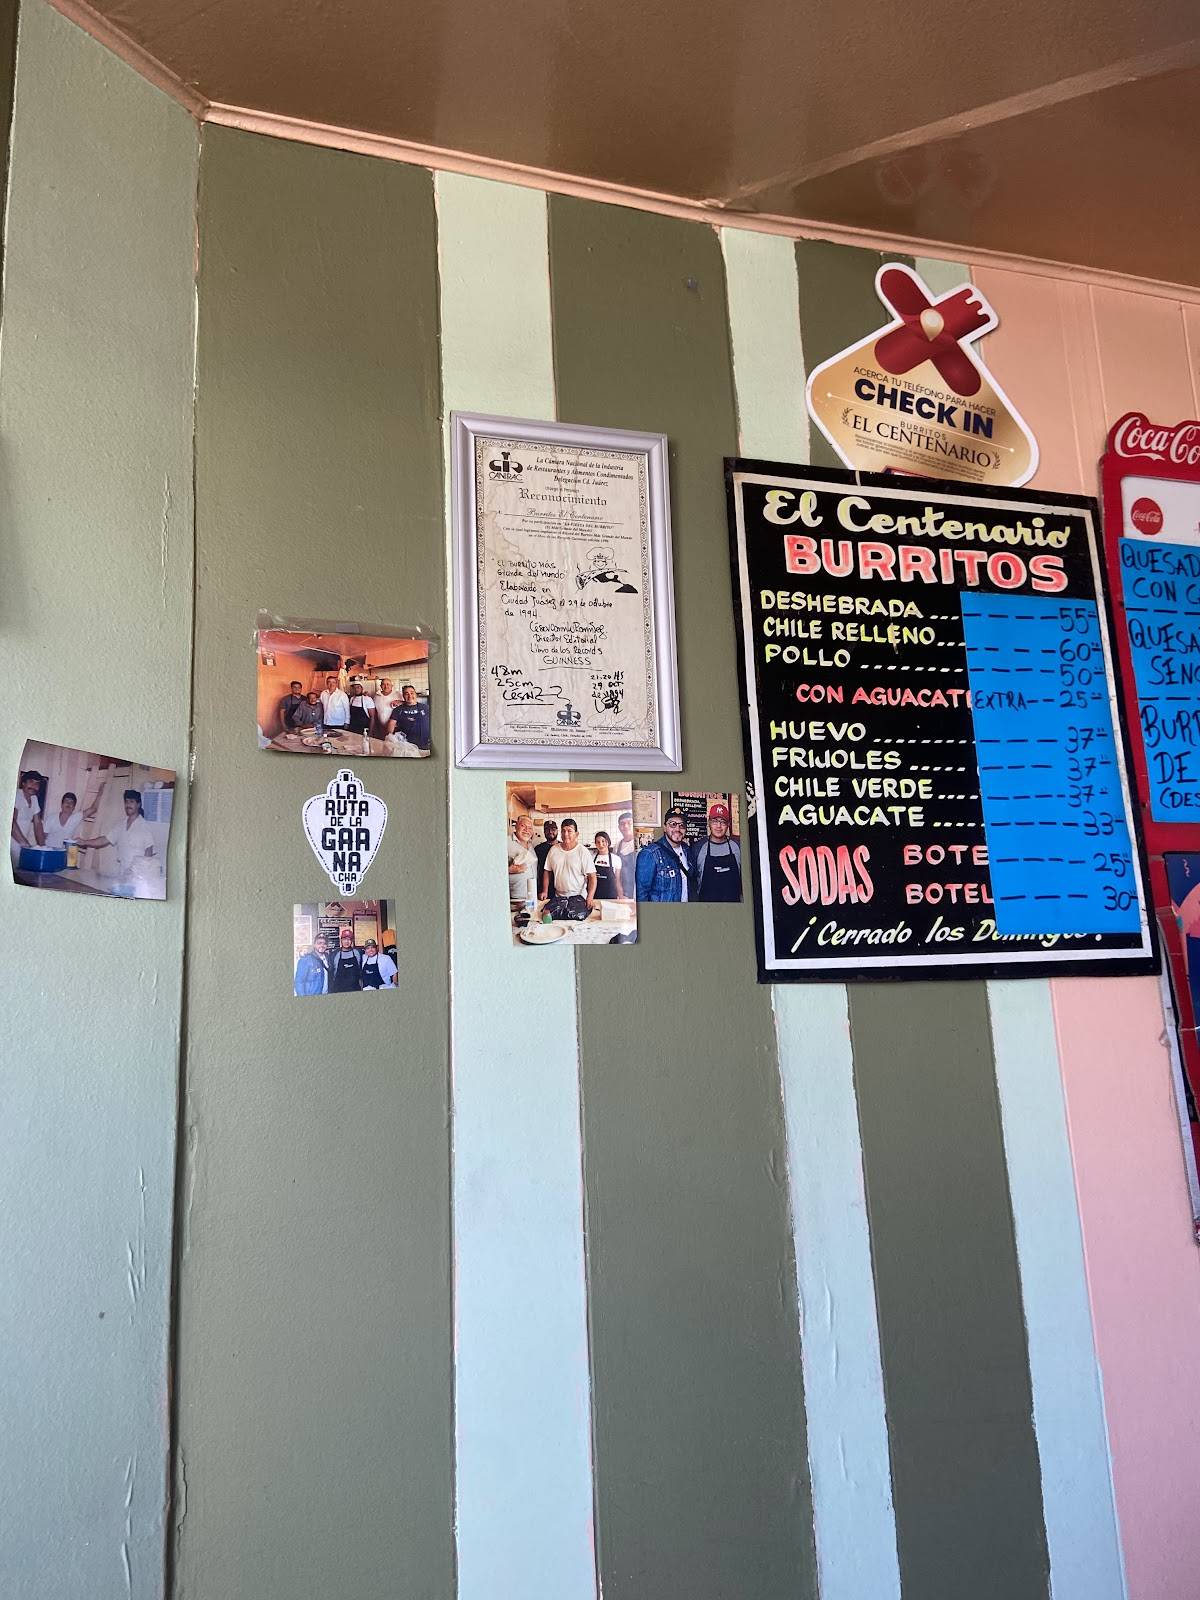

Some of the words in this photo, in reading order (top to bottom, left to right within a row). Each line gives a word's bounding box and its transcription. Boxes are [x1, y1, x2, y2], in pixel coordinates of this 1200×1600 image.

[854, 367, 888, 383] ACERCA
[891, 377, 902, 387] TU
[904, 380, 943, 400] TELÉFONO
[945, 396, 967, 408] PARA
[969, 402, 995, 417] HACER
[854, 379, 957, 428] CHECK
[963, 411, 993, 439] IN
[852, 415, 872, 432] EL
[876, 422, 991, 468] CENTENARIO
[900, 421, 947, 440] BURRITOS
[602, 462, 624, 470] Industria
[519, 487, 607, 506] Reconocimiento
[763, 490, 823, 527] El
[837, 496, 1070, 548] Centenario
[784, 534, 1068, 592] BURRITOS
[501, 594, 528, 605] Ciudad
[1132, 577, 1177, 602] CON
[760, 589, 925, 619] DESHEBRADA
[763, 616, 823, 640] CHILE
[831, 621, 936, 645] RELLENO
[543, 655, 591, 665] GUINNESS
[765, 643, 850, 667] POLLO
[796, 683, 844, 704] CON
[974, 690, 1028, 712] EXTRA
[769, 720, 867, 742] HUEVO
[772, 747, 902, 770] FRIJOLES
[1153, 751, 1198, 784] DE
[336, 783, 357, 799] LA
[774, 776, 841, 798] CHILE
[852, 777, 934, 800] VERDE
[325, 800, 369, 817] RUTA
[778, 804, 925, 827] AGUACATE
[331, 817, 343, 827] DE
[350, 817, 362, 827] LA
[333, 852, 361, 872] NA
[338, 873, 357, 882] CHA
[779, 844, 875, 906] SODAS
[925, 916, 965, 944] los
